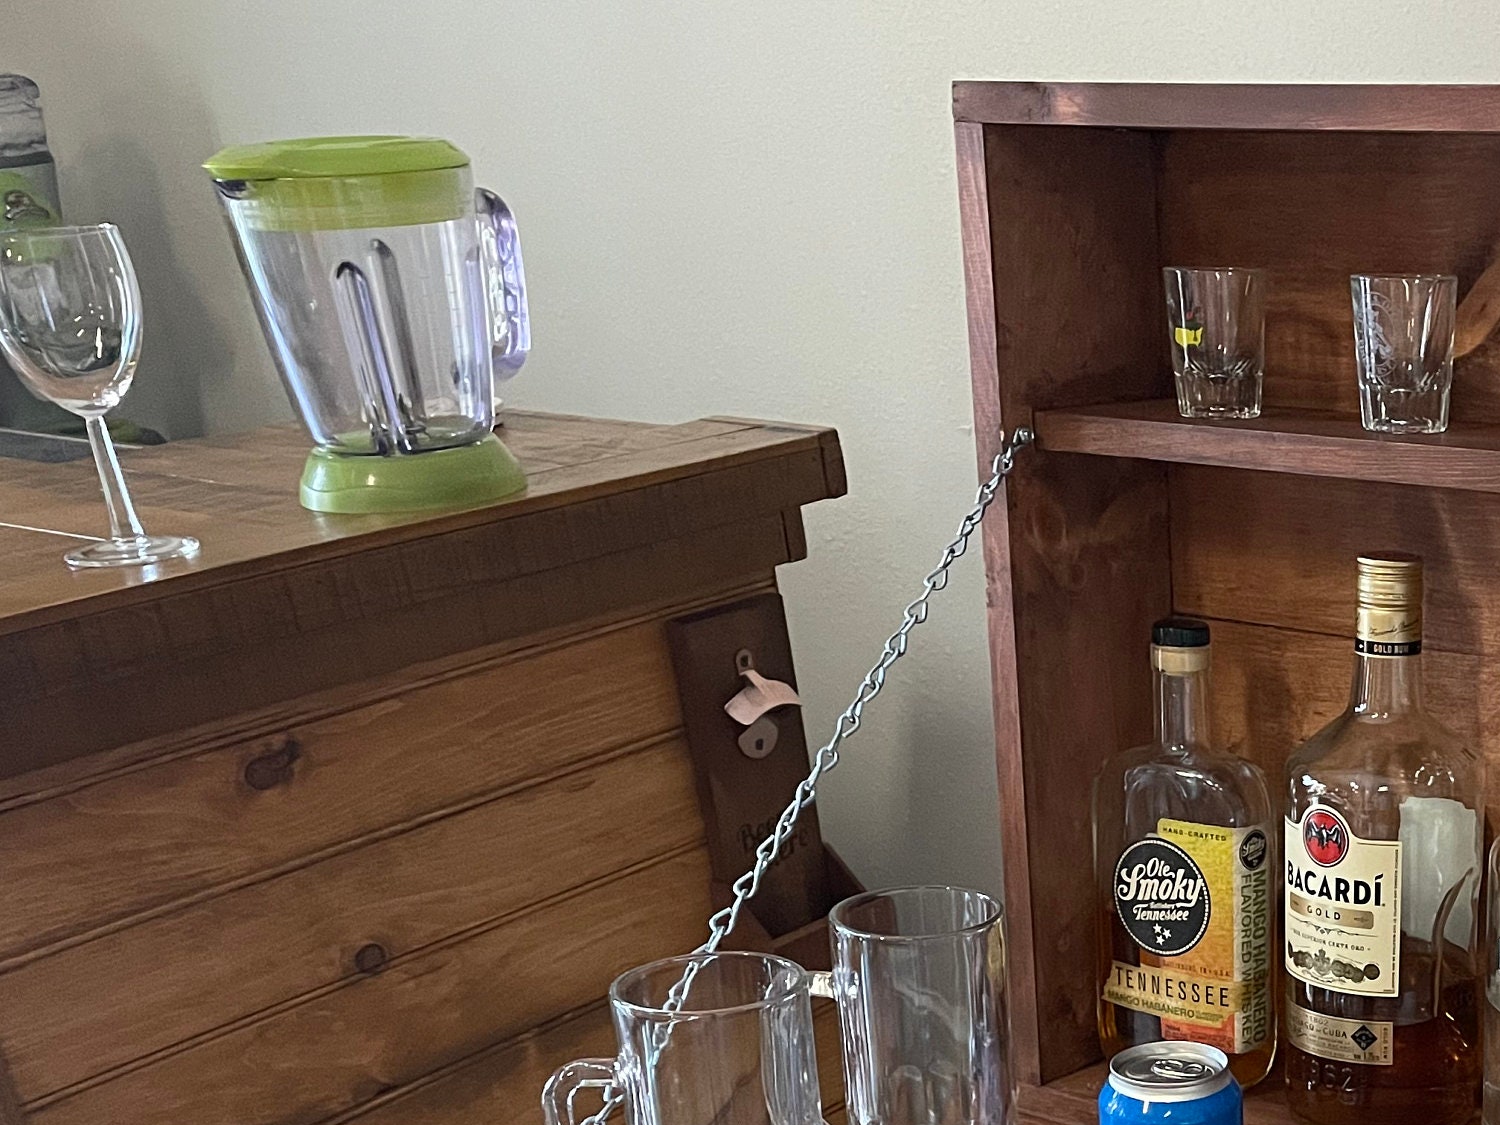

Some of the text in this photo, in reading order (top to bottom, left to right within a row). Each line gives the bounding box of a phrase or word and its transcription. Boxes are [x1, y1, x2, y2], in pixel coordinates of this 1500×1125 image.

[1373, 643, 1393, 654] GOLD
[1162, 826, 1227, 842] HAND-CRAFTED
[1146, 857, 1175, 878] Ole
[1117, 863, 1204, 908] Smoky
[1287, 859, 1384, 907] BACARDÍ
[1132, 903, 1190, 921] Tennessee
[1252, 869, 1267, 939] MANGO
[1306, 905, 1341, 920] GOLD
[1241, 874, 1253, 1047] FLAVORED WHISKEY
[1115, 966, 1230, 1008] TENNESSEE
[1252, 944, 1267, 1043] HABANERO
[1107, 989, 1140, 1006] MANGO
[1142, 998, 1195, 1019] HABANERO
[1322, 1028, 1348, 1039] CUBA
